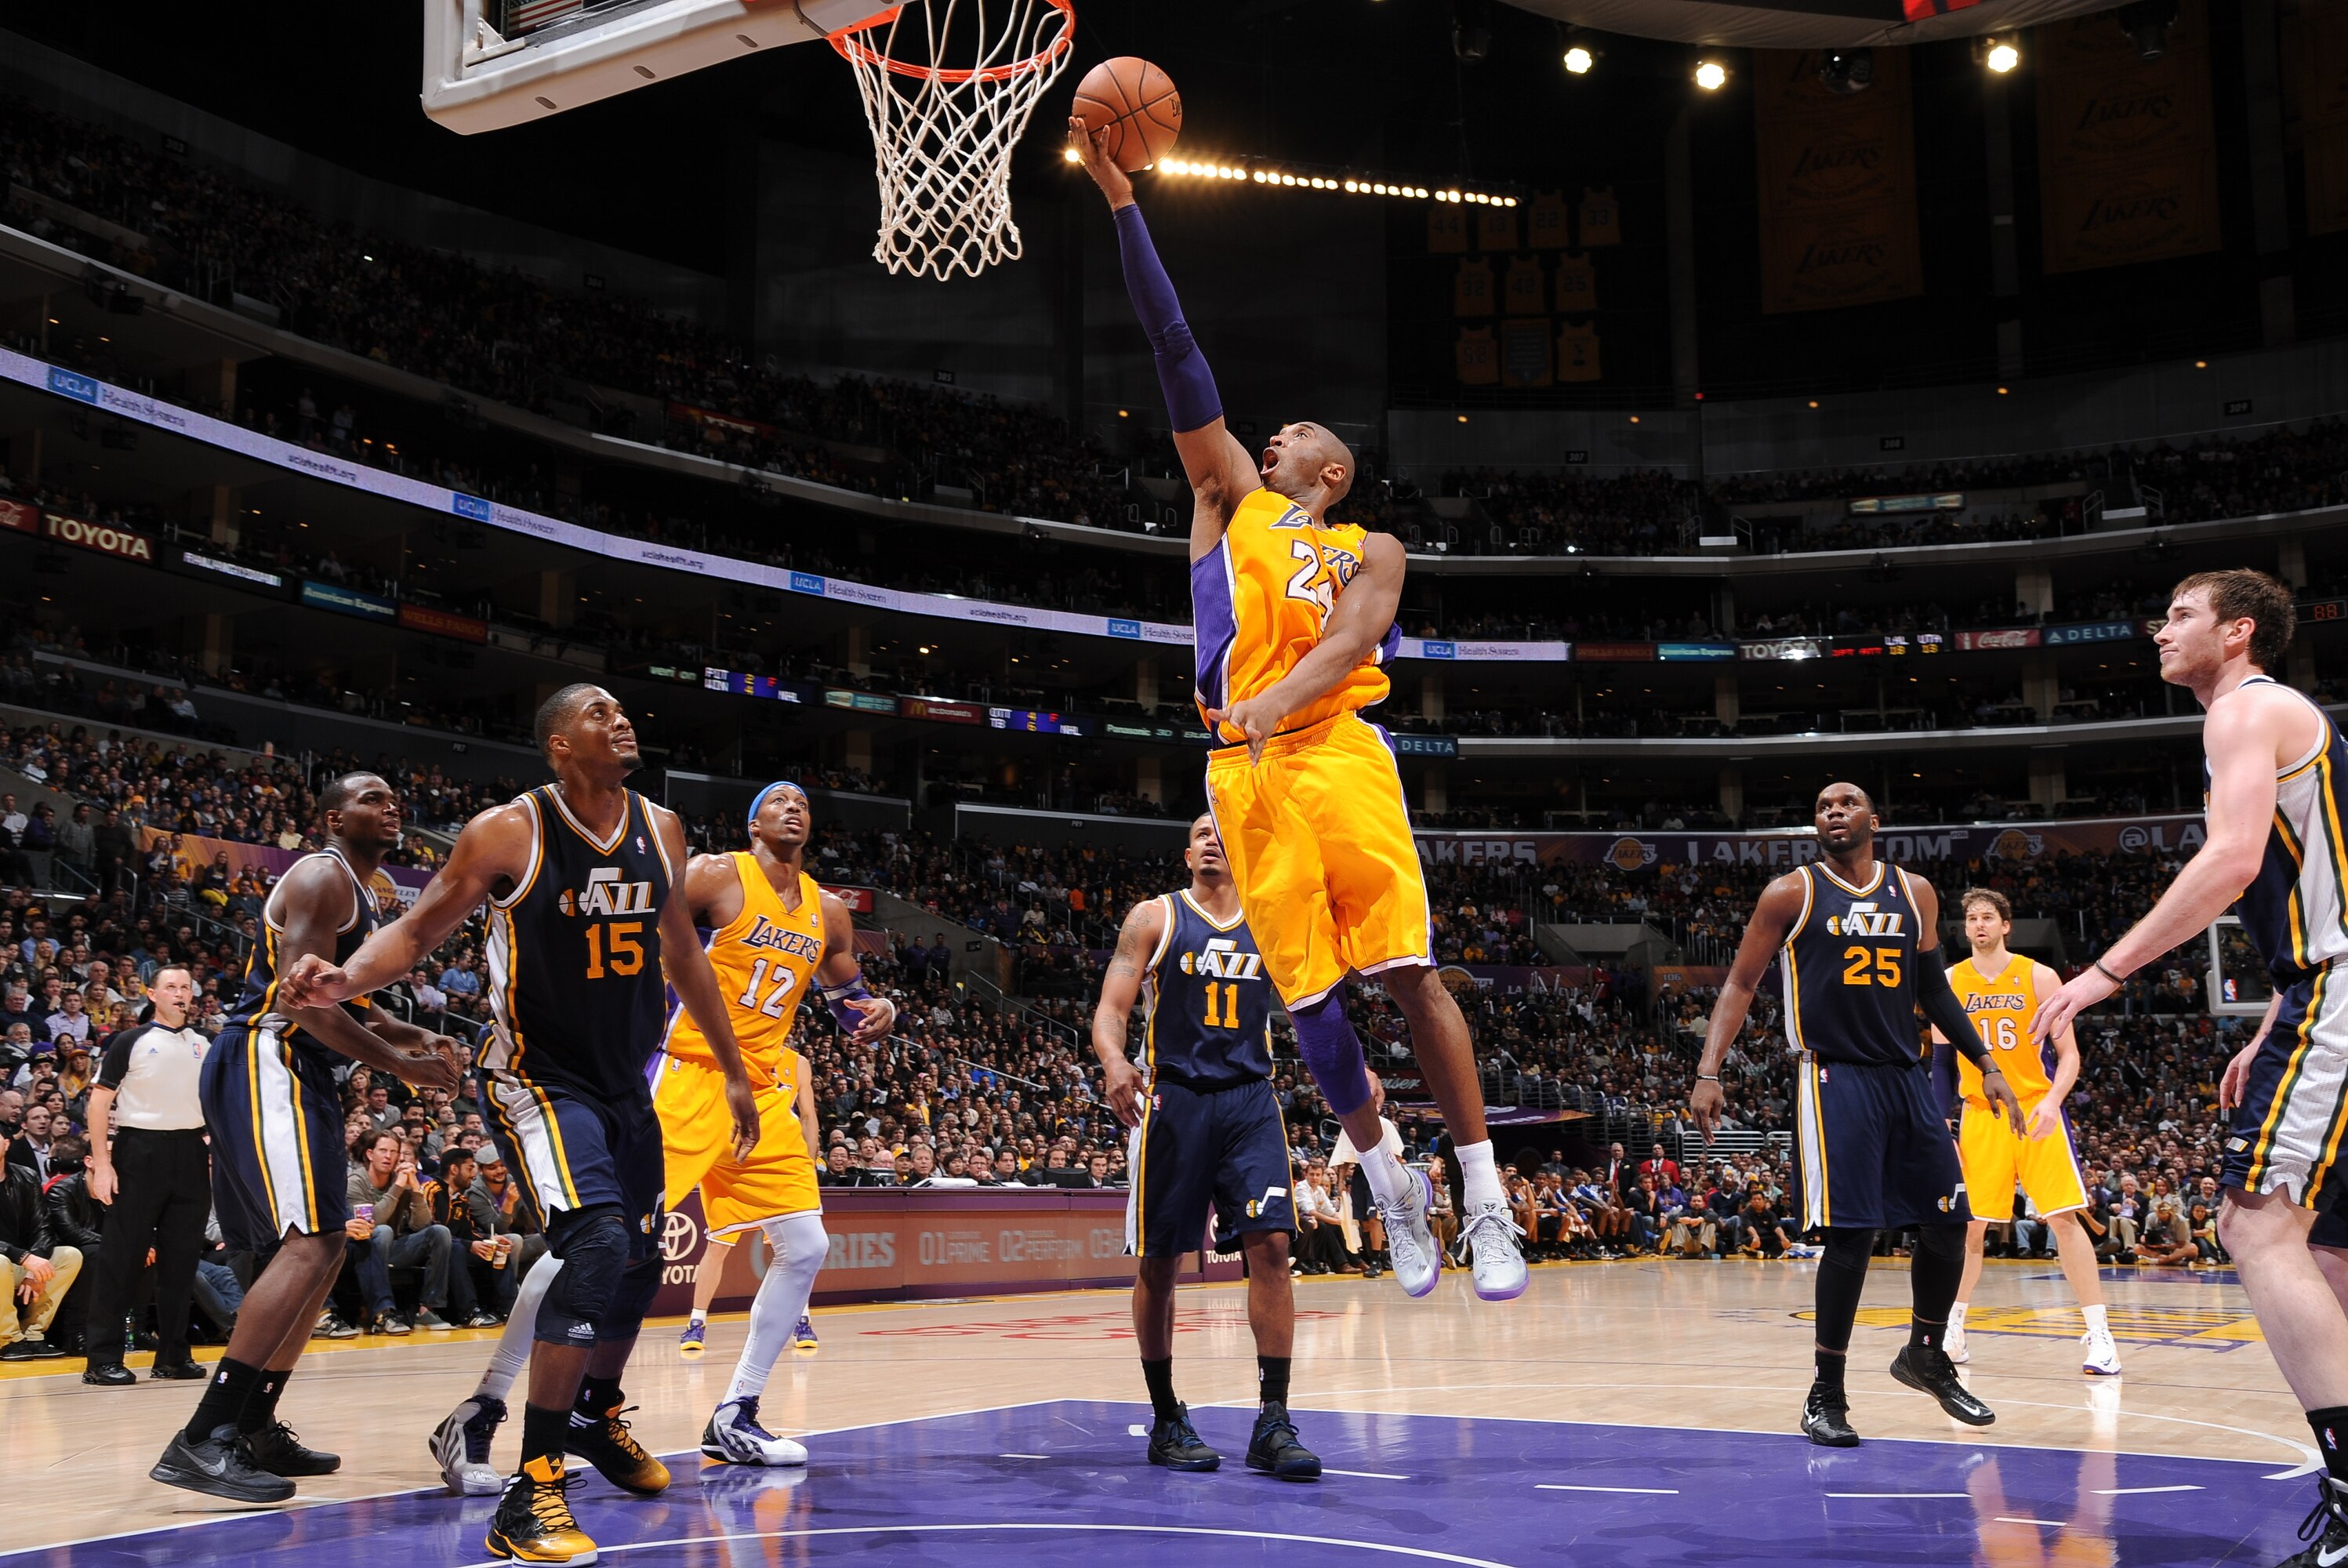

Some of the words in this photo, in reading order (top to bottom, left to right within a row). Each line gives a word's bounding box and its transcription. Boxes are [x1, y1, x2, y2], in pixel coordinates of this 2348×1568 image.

[53, 373, 93, 397] UCLA
[1569, 452, 1584, 462] 307
[45, 514, 151, 560] TOYOTA
[1268, 503, 1360, 588] LAERS
[794, 575, 822, 592] UCLA
[828, 582, 857, 599] Health
[303, 586, 353, 606] American
[354, 596, 395, 617] Express
[401, 609, 445, 628] WELLS
[445, 619, 485, 637] FARGO
[1111, 621, 1138, 635] UCLA
[1144, 626, 1171, 639] Health
[2067, 626, 2132, 641] DELTA
[1427, 644, 1453, 655] UCLA
[1459, 646, 1490, 656] Health
[1577, 648, 1613, 657] WELLS
[1617, 648, 1653, 657] FARGO
[1659, 648, 1699, 656] American
[1700, 648, 1735, 657] Express
[1026, 711, 1037, 721] 4
[1049, 712, 1060, 723] F
[1026, 721, 1037, 732] 6
[1106, 724, 1152, 737] Panasonic
[1156, 728, 1174, 738] 3D
[1401, 739, 1456, 753] DELTA
[1416, 840, 1536, 866] AKERS
[1603, 844, 1657, 864] LAKERS
[572, 866, 657, 916] JAZZ
[1836, 902, 1907, 937] JAZZ
[585, 921, 644, 979] 15
[740, 913, 822, 966] LAKERS
[1192, 937, 1263, 982] JAZZ
[1843, 946, 1902, 989] 25
[737, 956, 797, 1021] 12
[1203, 981, 1240, 1029] 11
[1964, 992, 2026, 1014] LAKERS
[1978, 1017, 2018, 1051] 16
[1381, 1073, 1421, 1090] eiser
[823, 1232, 896, 1269] RIES
[999, 1229, 1025, 1262] 02
[662, 1264, 701, 1285] YOT
